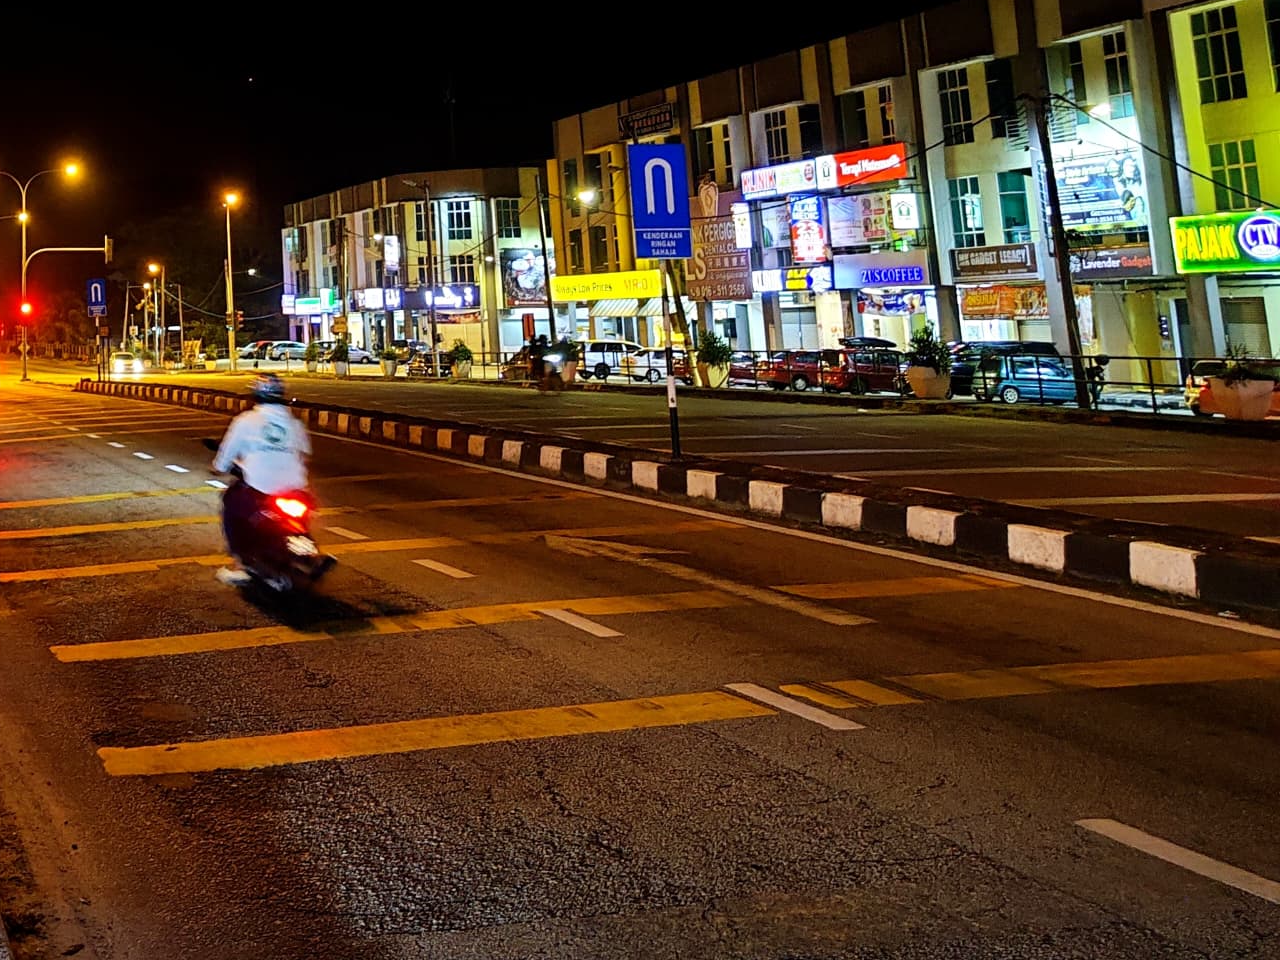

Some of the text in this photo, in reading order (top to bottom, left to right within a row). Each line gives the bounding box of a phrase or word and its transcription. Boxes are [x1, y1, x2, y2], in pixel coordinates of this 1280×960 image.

[643, 231, 683, 239] KENDERAAN
[1245, 223, 1278, 246] CTW
[1176, 224, 1239, 261] PAJAK
[652, 248, 677, 256] SAHAJA
[970, 251, 997, 265] GADGET
[999, 248, 1026, 263] LEGACY
[1082, 255, 1152, 269] Lavender Gadget
[861, 268, 921, 282] ZUS COFFEE
